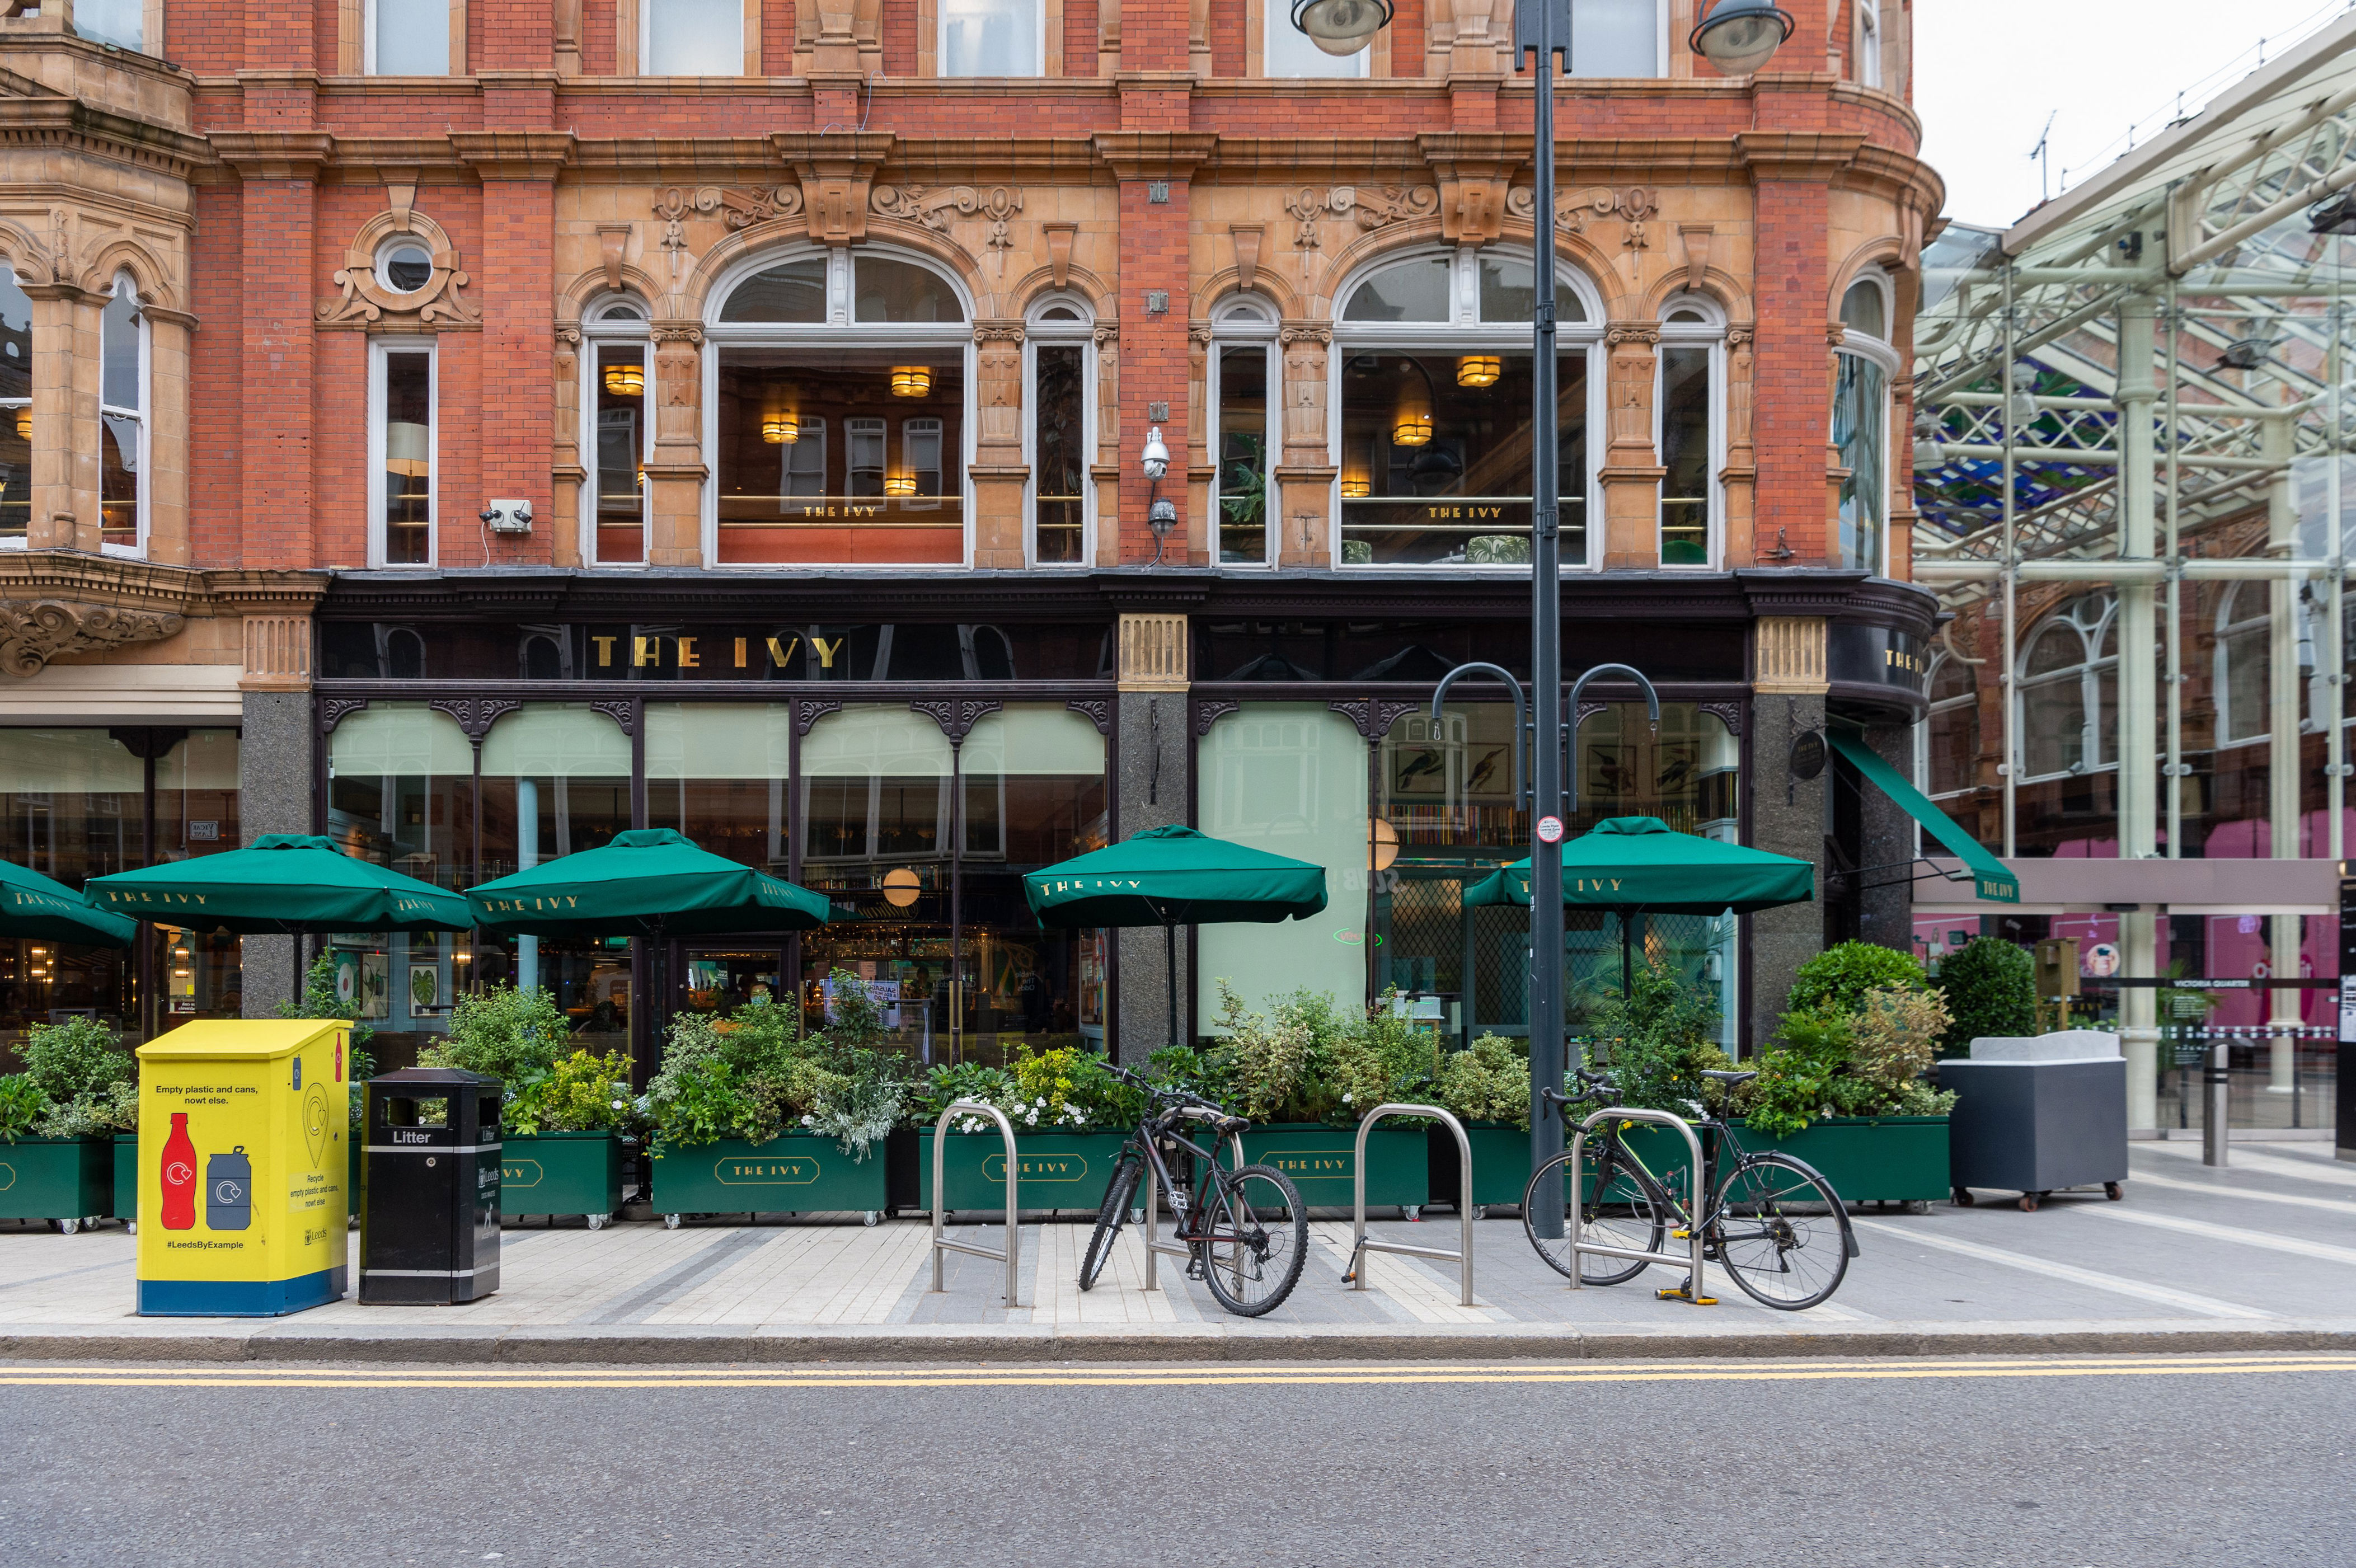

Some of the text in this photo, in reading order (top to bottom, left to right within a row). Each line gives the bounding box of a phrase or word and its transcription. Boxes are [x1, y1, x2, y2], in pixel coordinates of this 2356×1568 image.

[804, 506, 876, 517] THE IVY
[1429, 508, 1501, 518] THE IVY
[592, 636, 843, 668] THE IVY
[1885, 650, 1911, 670] THE
[1041, 880, 1083, 895] THE
[1578, 879, 1622, 891] IVY
[1983, 881, 2013, 898] THE IVY
[15, 893, 71, 910] THE IVY
[107, 891, 206, 904] THE IVY
[483, 896, 578, 911] THE IVY
[398, 899, 419, 910] THE
[156, 1086, 183, 1095] Empty
[185, 1086, 214, 1095] plastic
[393, 1131, 431, 1143] Litter
[482, 1130, 495, 1142] Litter
[1001, 1163, 1068, 1172] TE IVY
[1278, 1159, 1345, 1169] THE IVY
[485, 1167, 499, 1183] Leeds
[503, 1168, 524, 1178] VY
[734, 1166, 801, 1175] THE IVY
[307, 1173, 324, 1184] Recycle
[290, 1189, 304, 1198] empty
[304, 1187, 319, 1197] plastic
[320, 1185, 328, 1193] and
[305, 1198, 326, 1208] nowt else
[312, 1228, 327, 1240] Leeds
[167, 1241, 243, 1250] #LeedsByExample
